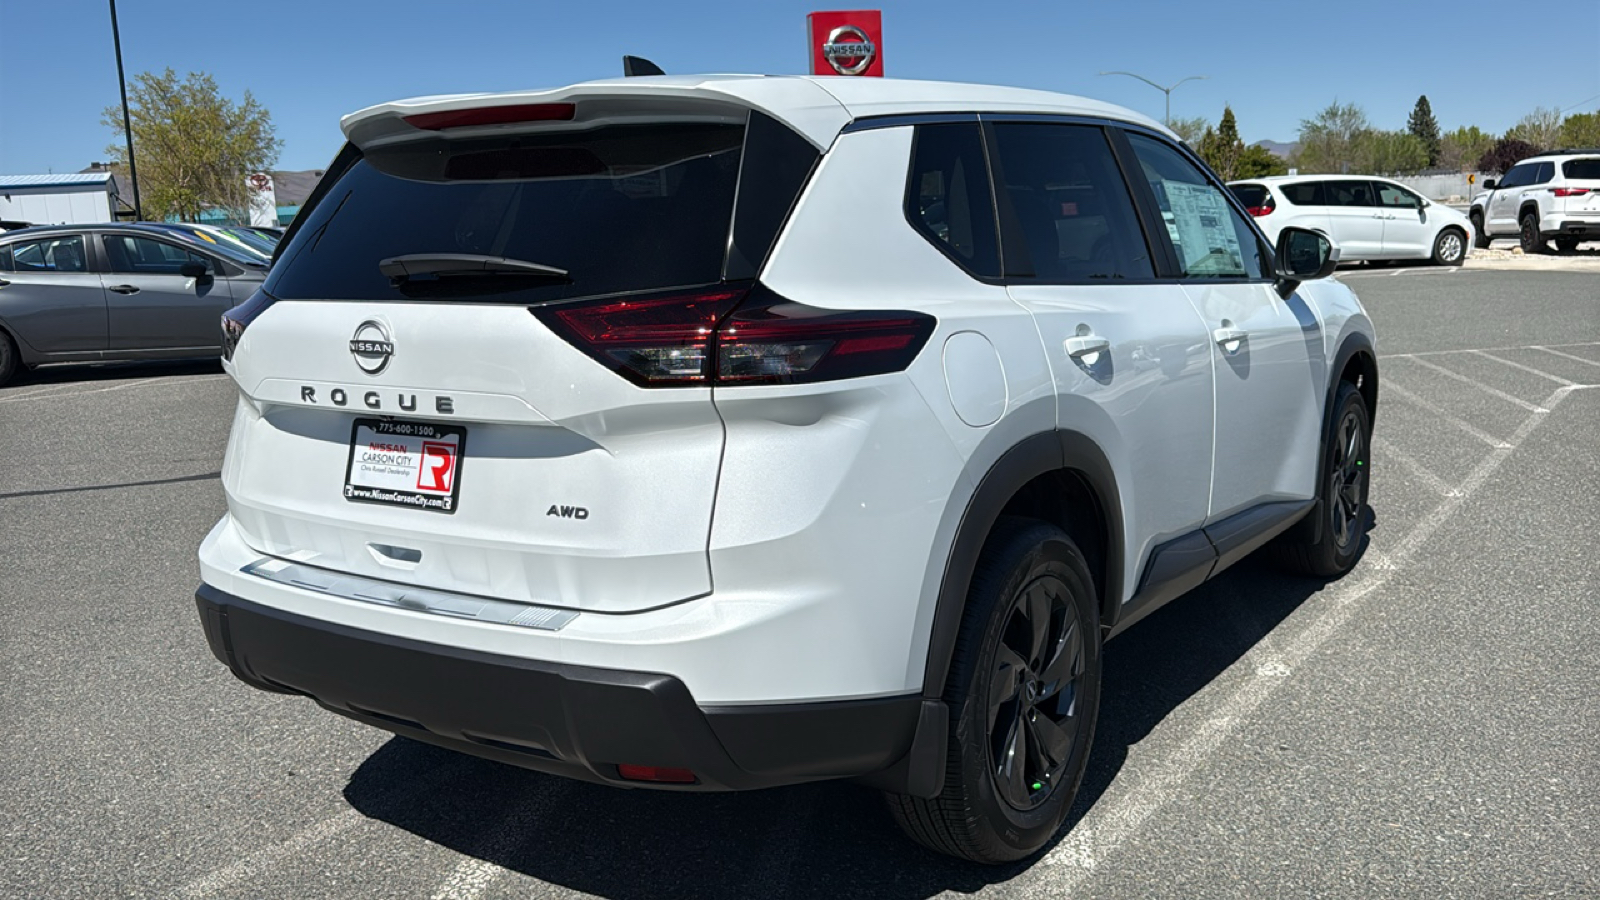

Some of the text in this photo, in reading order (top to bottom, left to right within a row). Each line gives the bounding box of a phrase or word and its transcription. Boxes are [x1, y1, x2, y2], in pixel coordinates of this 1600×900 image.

[829, 45, 871, 54] NISSAN
[350, 341, 392, 352] NISSAN
[301, 386, 454, 415] ROGUE
[379, 423, 434, 436] 775-600-1500
[369, 442, 407, 454] NISSAN
[362, 452, 413, 466] CARSON CITY
[354, 489, 442, 508] www.NissanCarsonCity.com
[546, 505, 589, 520] AWD
